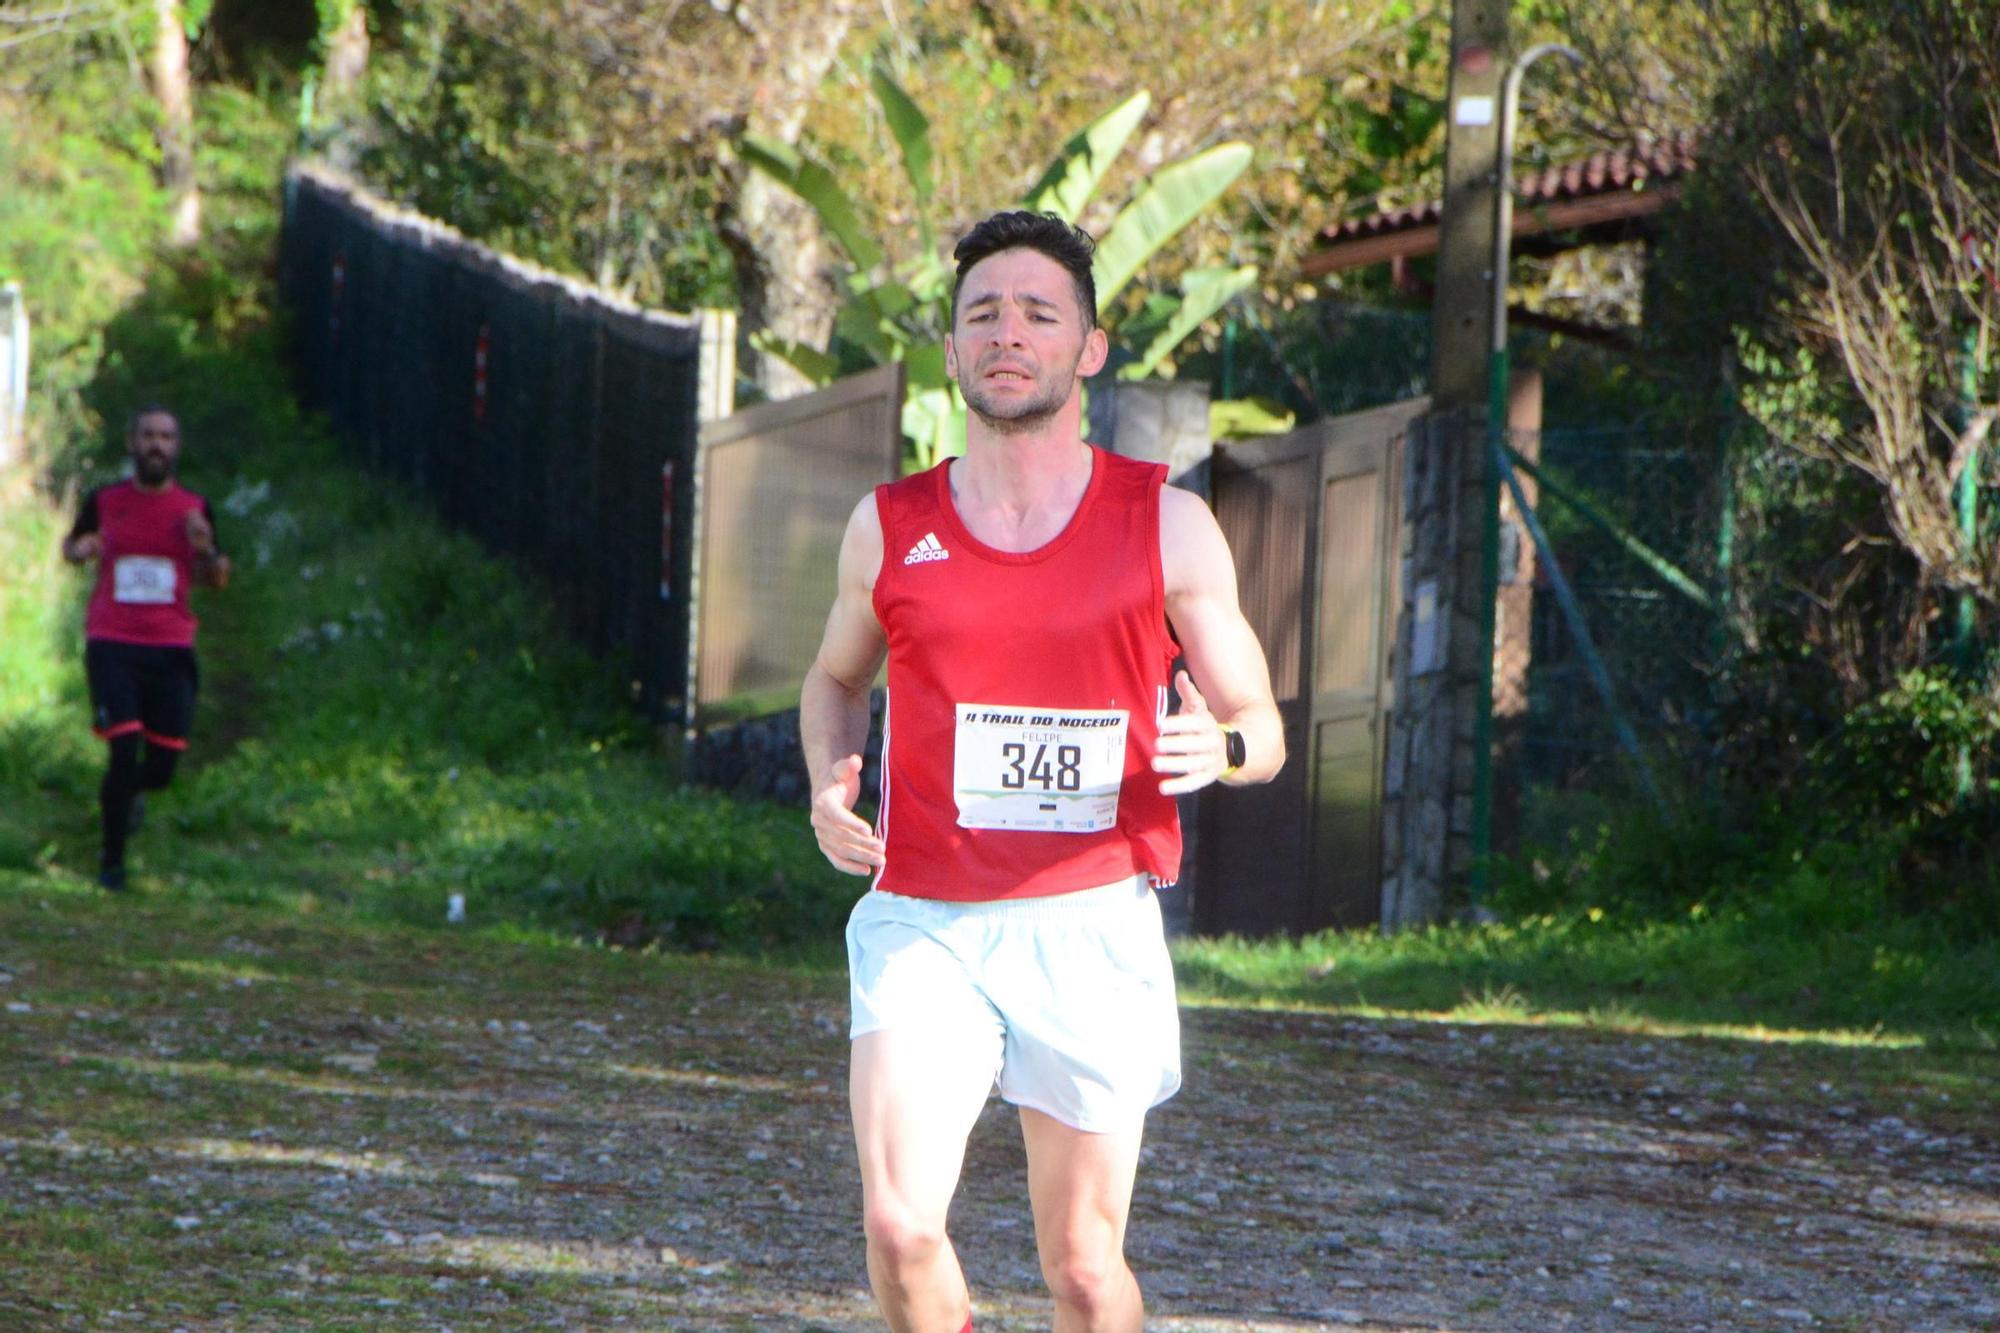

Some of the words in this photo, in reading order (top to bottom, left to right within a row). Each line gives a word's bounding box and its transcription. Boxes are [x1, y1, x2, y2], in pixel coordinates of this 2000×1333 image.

[904, 549, 949, 565] adidas
[982, 713, 1025, 725] TRAIL
[1030, 716, 1053, 726] DO
[1022, 732, 1062, 742] FELIPE
[1002, 743, 1081, 791] 348
